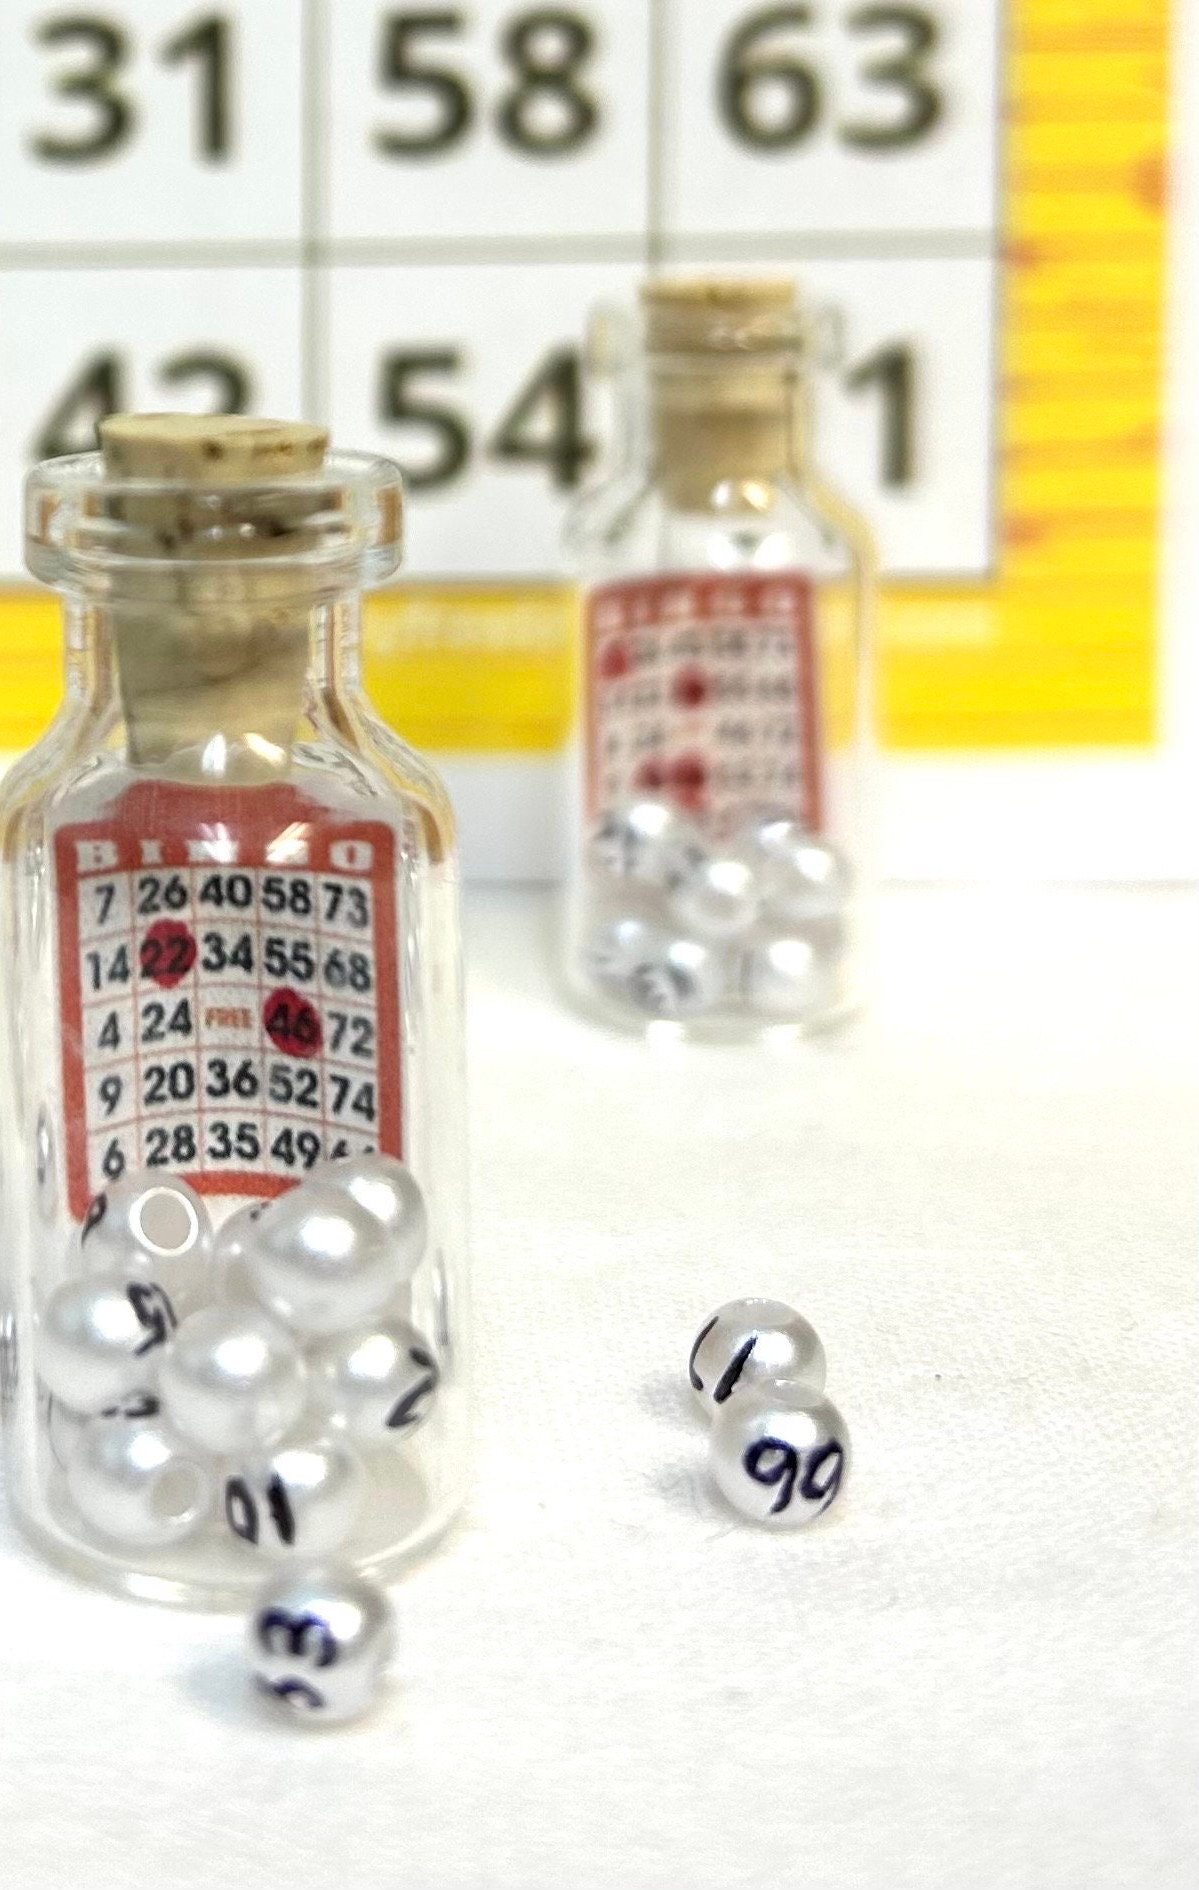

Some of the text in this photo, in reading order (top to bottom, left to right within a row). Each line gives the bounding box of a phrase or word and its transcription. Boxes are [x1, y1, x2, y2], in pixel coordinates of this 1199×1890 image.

[28, 12, 240, 166] 31
[373, 8, 600, 161] 58
[716, 4, 944, 153] 63
[375, 345, 595, 495] 54
[75, 838, 375, 874] BINO
[95, 873, 370, 930] 7 26 40 58 73
[85, 932, 373, 993] 14 22 34 55 68
[97, 997, 375, 1059] 4 24 FREE 46 72
[98, 1058, 377, 1123] 9 20 36 52 74
[102, 1138, 127, 1181] 6
[144, 1123, 198, 1168] 28
[206, 1121, 262, 1161] 35
[269, 1127, 323, 1170] 49
